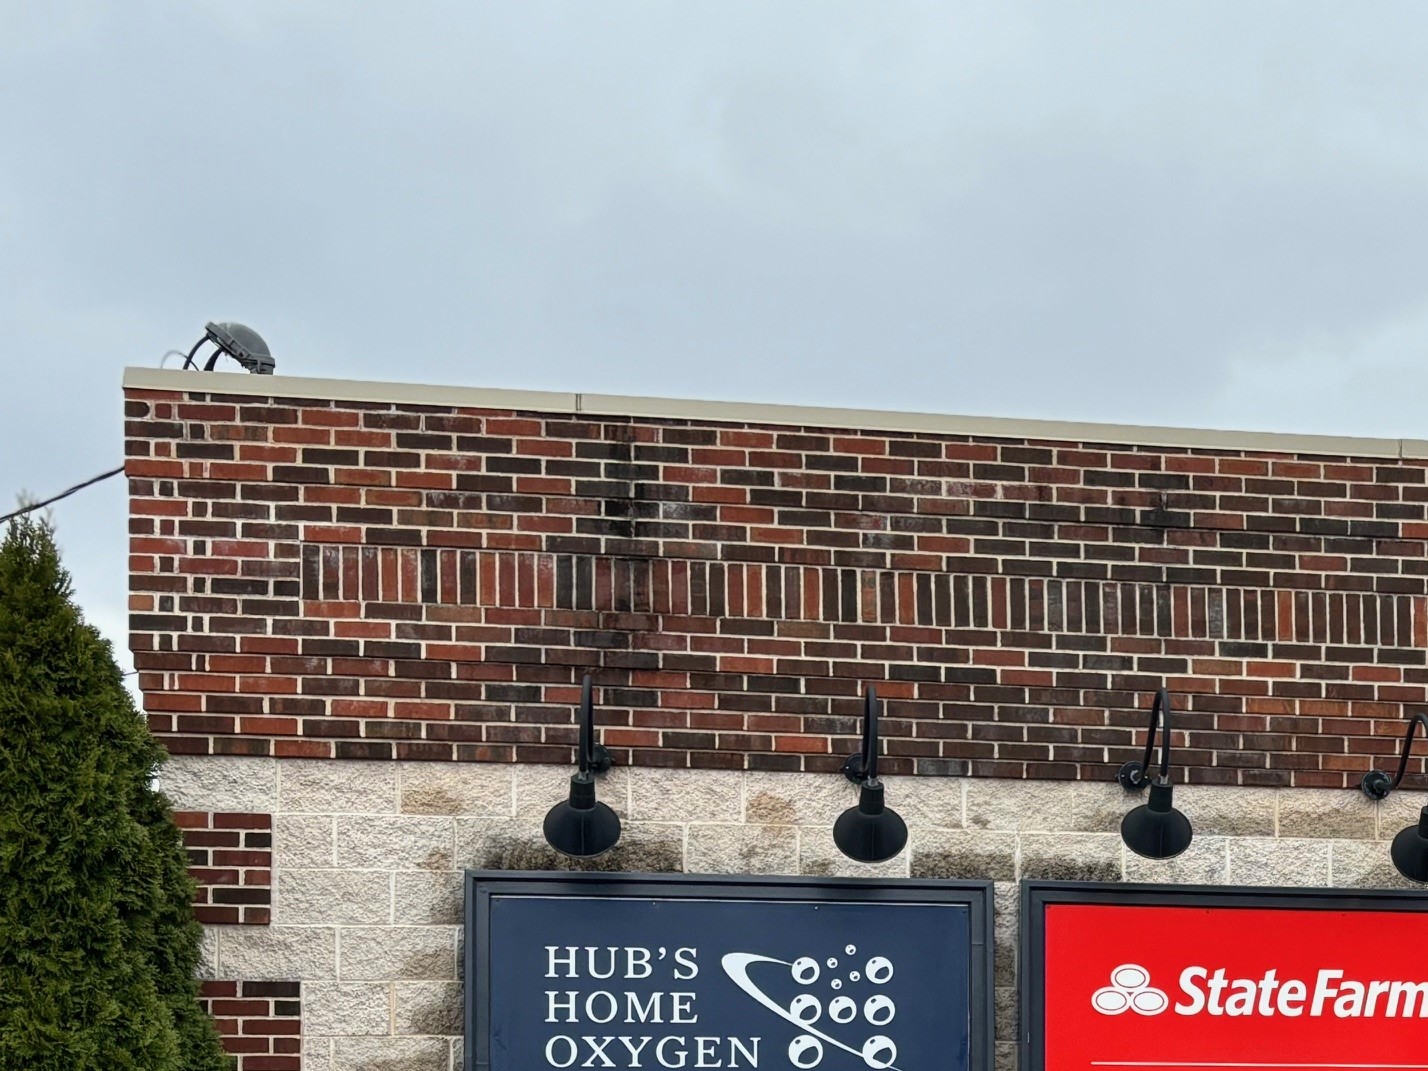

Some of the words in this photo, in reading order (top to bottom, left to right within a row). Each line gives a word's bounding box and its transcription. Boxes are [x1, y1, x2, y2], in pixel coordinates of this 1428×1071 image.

[544, 945, 699, 979] HUB'S
[544, 990, 698, 1024] HOME
[545, 1035, 762, 1069] OXYGEN
